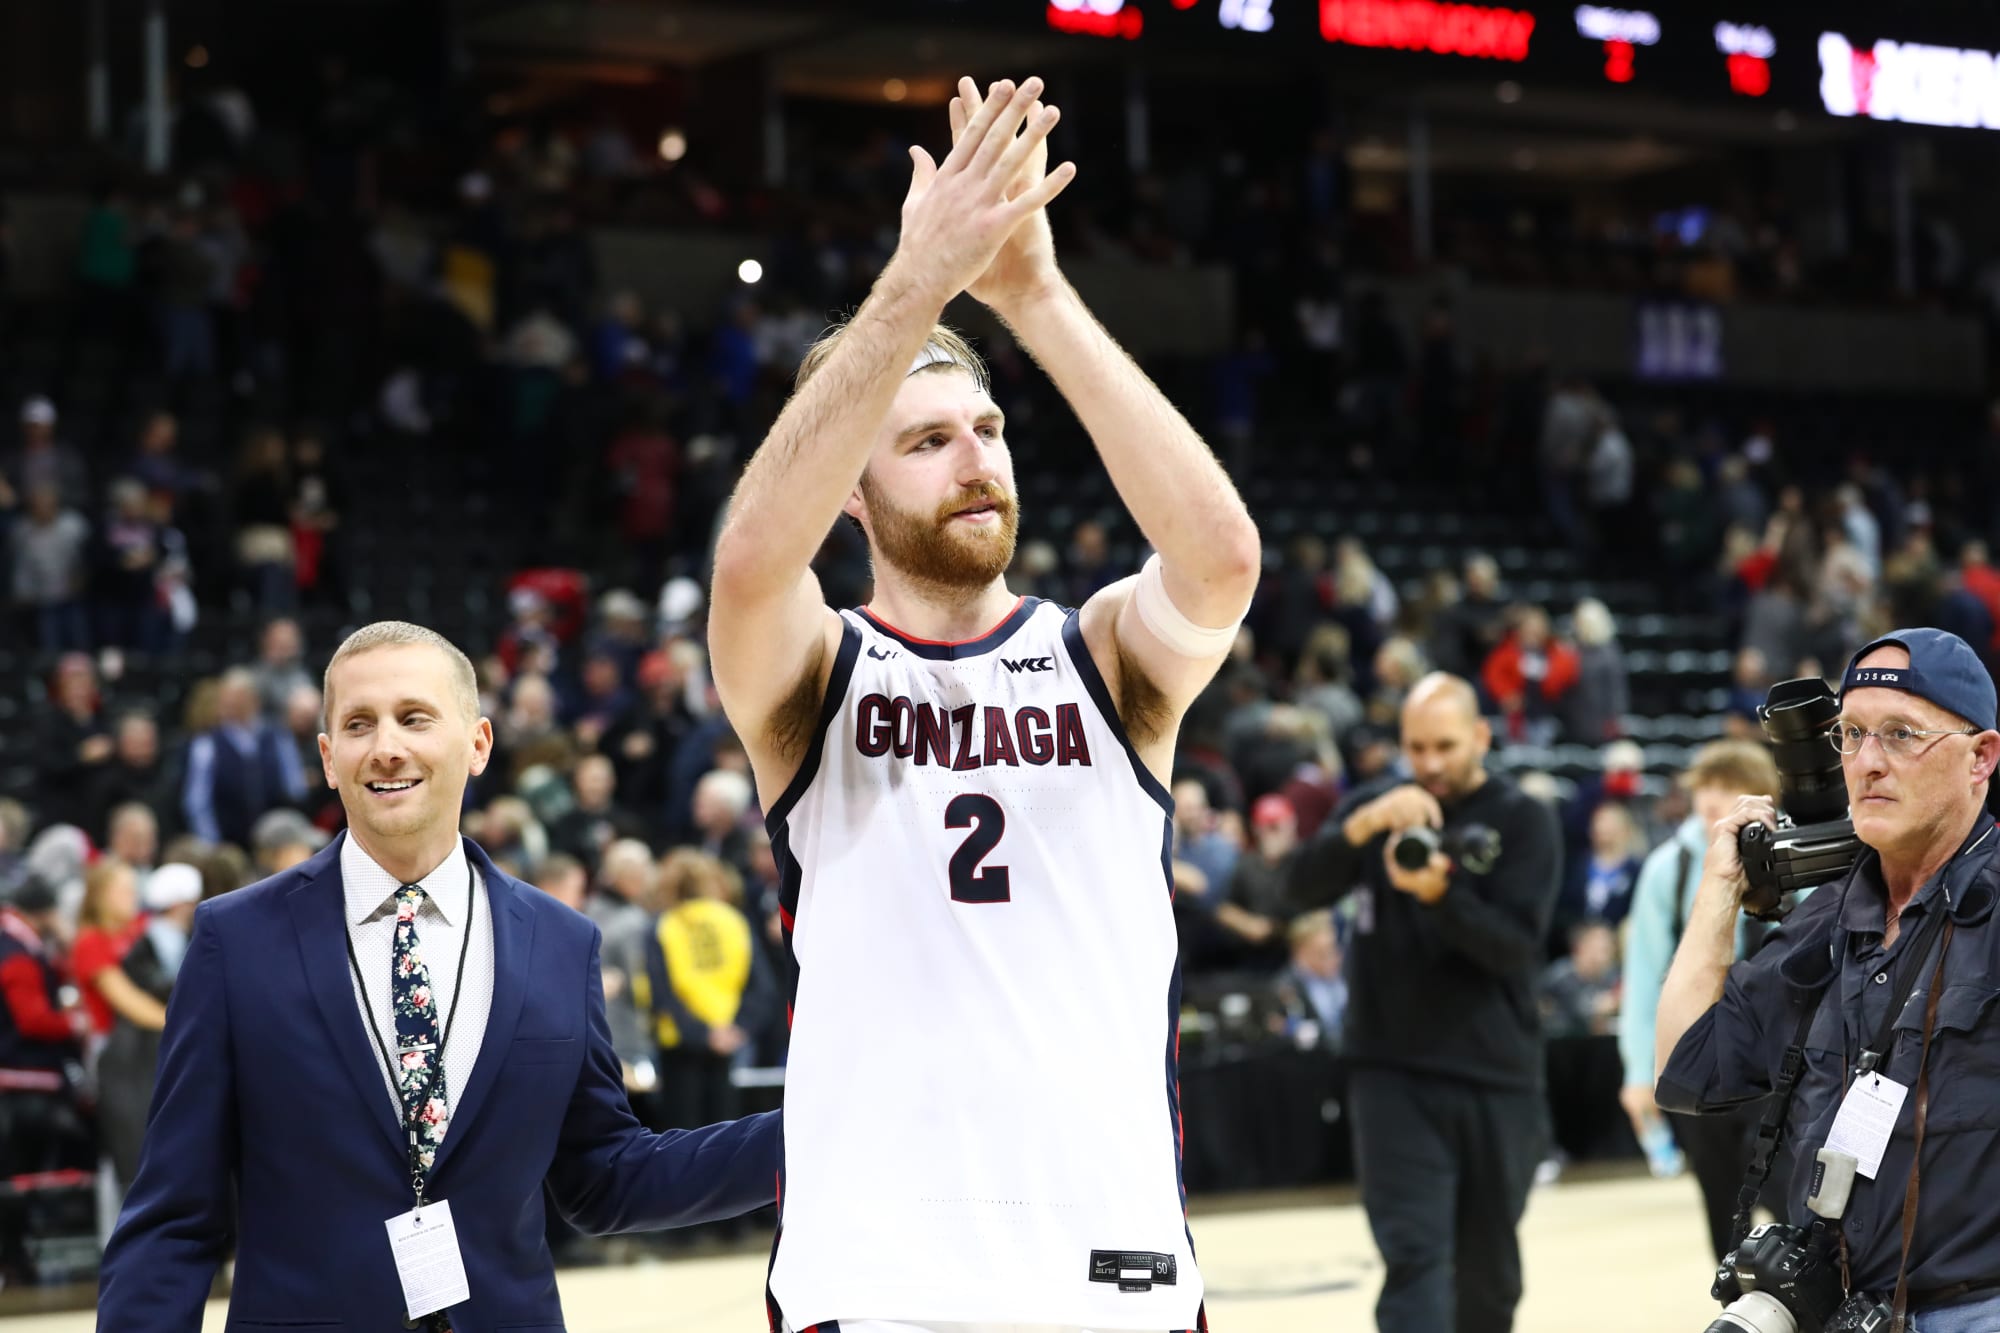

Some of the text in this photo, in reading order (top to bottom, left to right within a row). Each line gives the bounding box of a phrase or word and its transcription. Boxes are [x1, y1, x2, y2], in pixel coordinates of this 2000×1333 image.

[1000, 656, 1054, 674] WCC
[856, 693, 1092, 771] GONZAGA
[944, 793, 1011, 904] 2
[1156, 1261, 1168, 1275] 50
